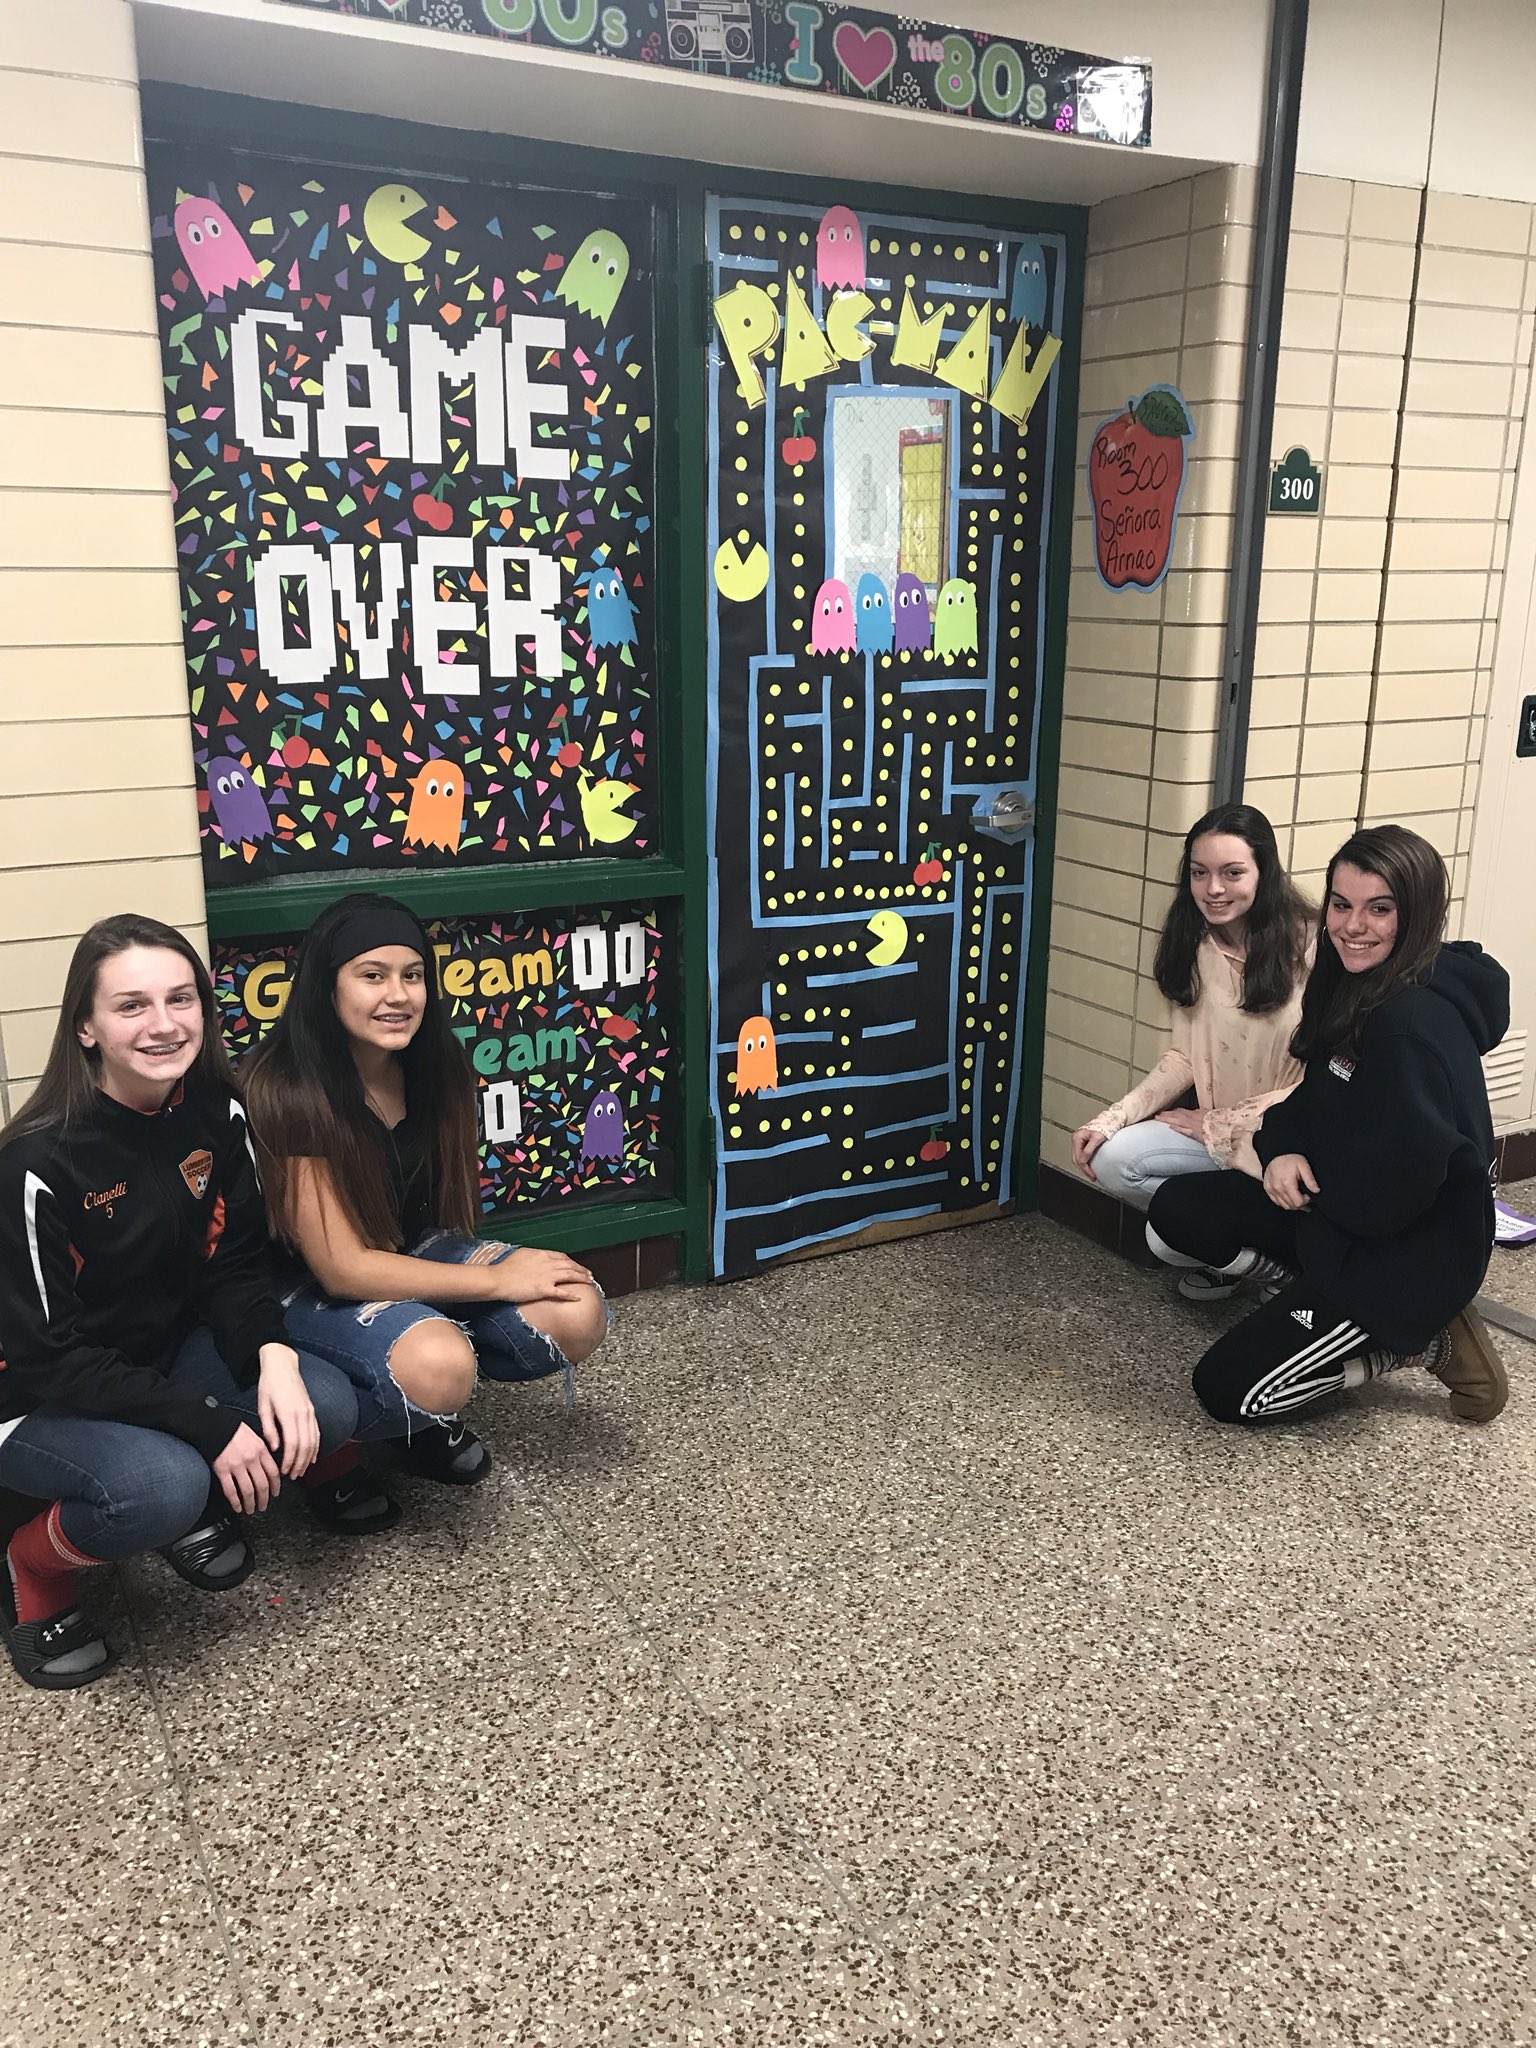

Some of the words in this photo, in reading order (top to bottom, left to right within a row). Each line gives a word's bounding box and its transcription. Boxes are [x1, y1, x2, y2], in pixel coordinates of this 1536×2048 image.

[785, 3, 824, 86] I
[907, 33, 945, 63] the
[934, 33, 1047, 119] 80s
[713, 268, 1064, 429] PAC-MAN
[230, 307, 571, 480] GAME
[1097, 436, 1137, 469] Room
[1116, 452, 1169, 496] 300
[1279, 476, 1314, 501] 300
[1100, 498, 1162, 543] Señora
[1105, 540, 1156, 575] Arnao
[253, 535, 564, 696] OVER
[84, 1181, 129, 1210] Cianelli
[105, 1202, 114, 1219] 5
[1290, 1310, 1314, 1330] adidas
